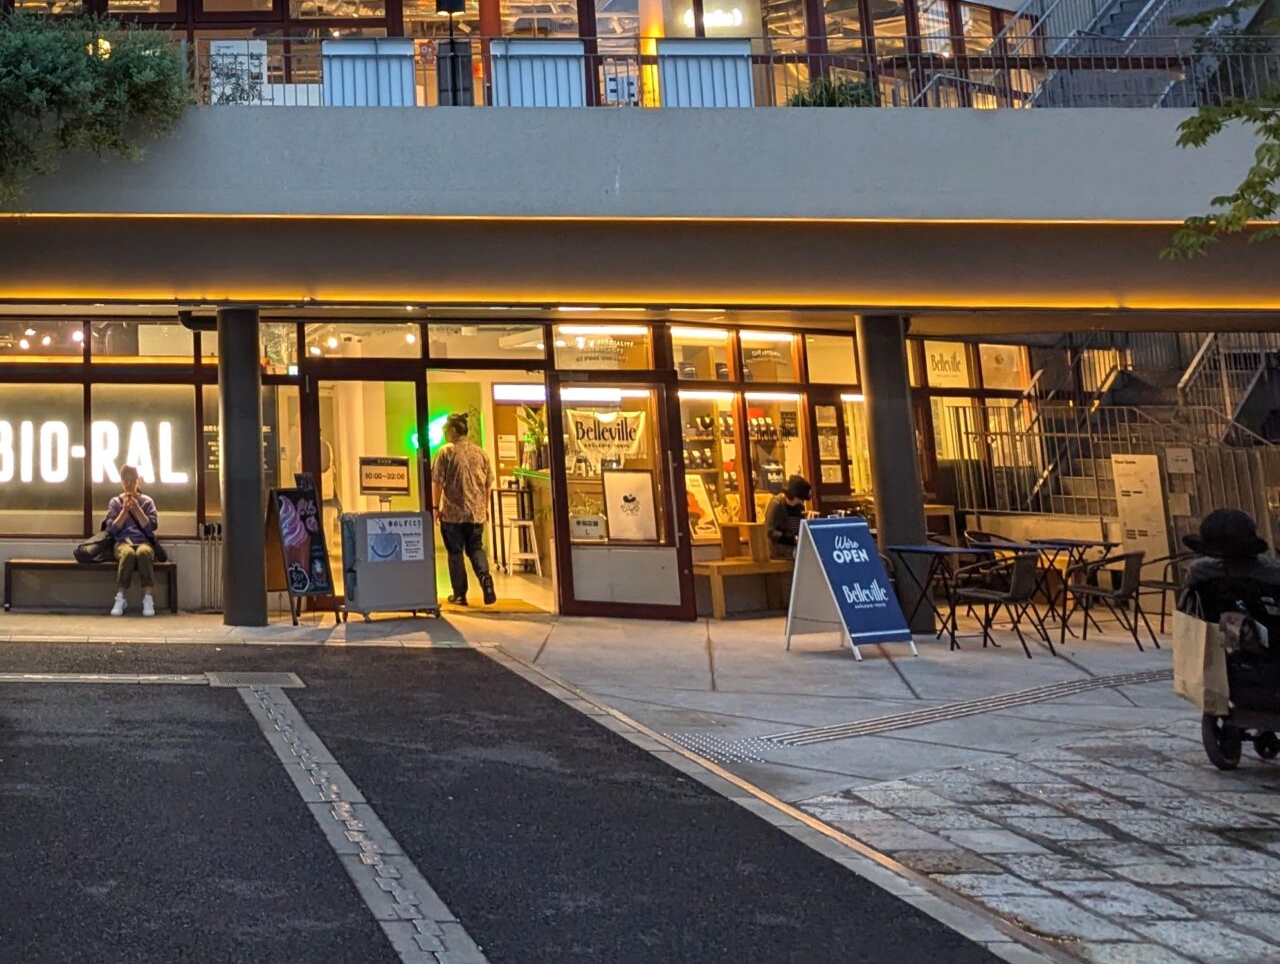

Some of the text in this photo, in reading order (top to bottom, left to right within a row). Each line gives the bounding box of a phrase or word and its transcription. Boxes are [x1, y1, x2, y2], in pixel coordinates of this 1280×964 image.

[931, 351, 961, 373] Belleville
[576, 417, 637, 441] Belleville
[833, 549, 869, 563] OPEN
[842, 579, 889, 603] Belleville
